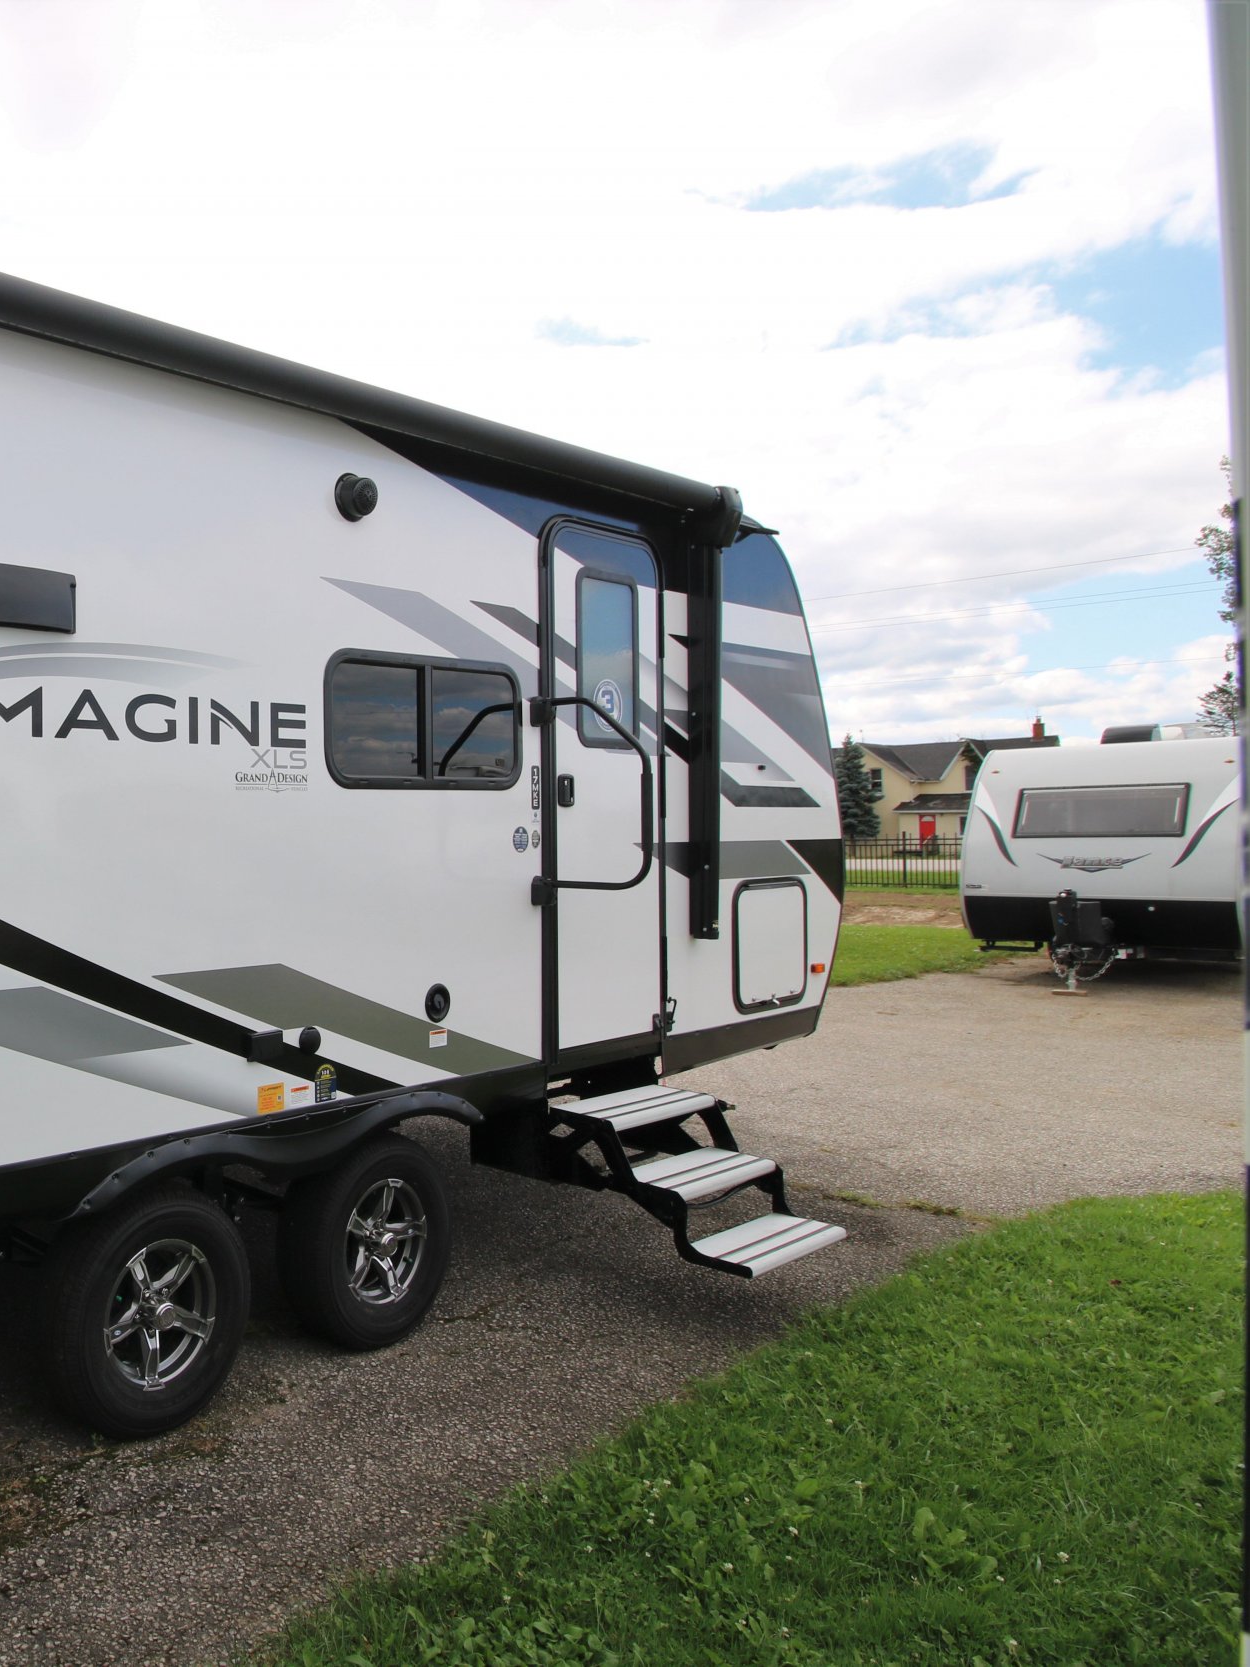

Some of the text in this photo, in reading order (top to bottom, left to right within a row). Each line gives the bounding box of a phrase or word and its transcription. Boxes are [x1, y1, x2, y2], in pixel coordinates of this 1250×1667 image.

[601, 690, 614, 713] 3
[250, 748, 307, 769] XLS
[235, 771, 308, 783] GRAND DESIGN
[532, 768, 540, 807] 17MKE
